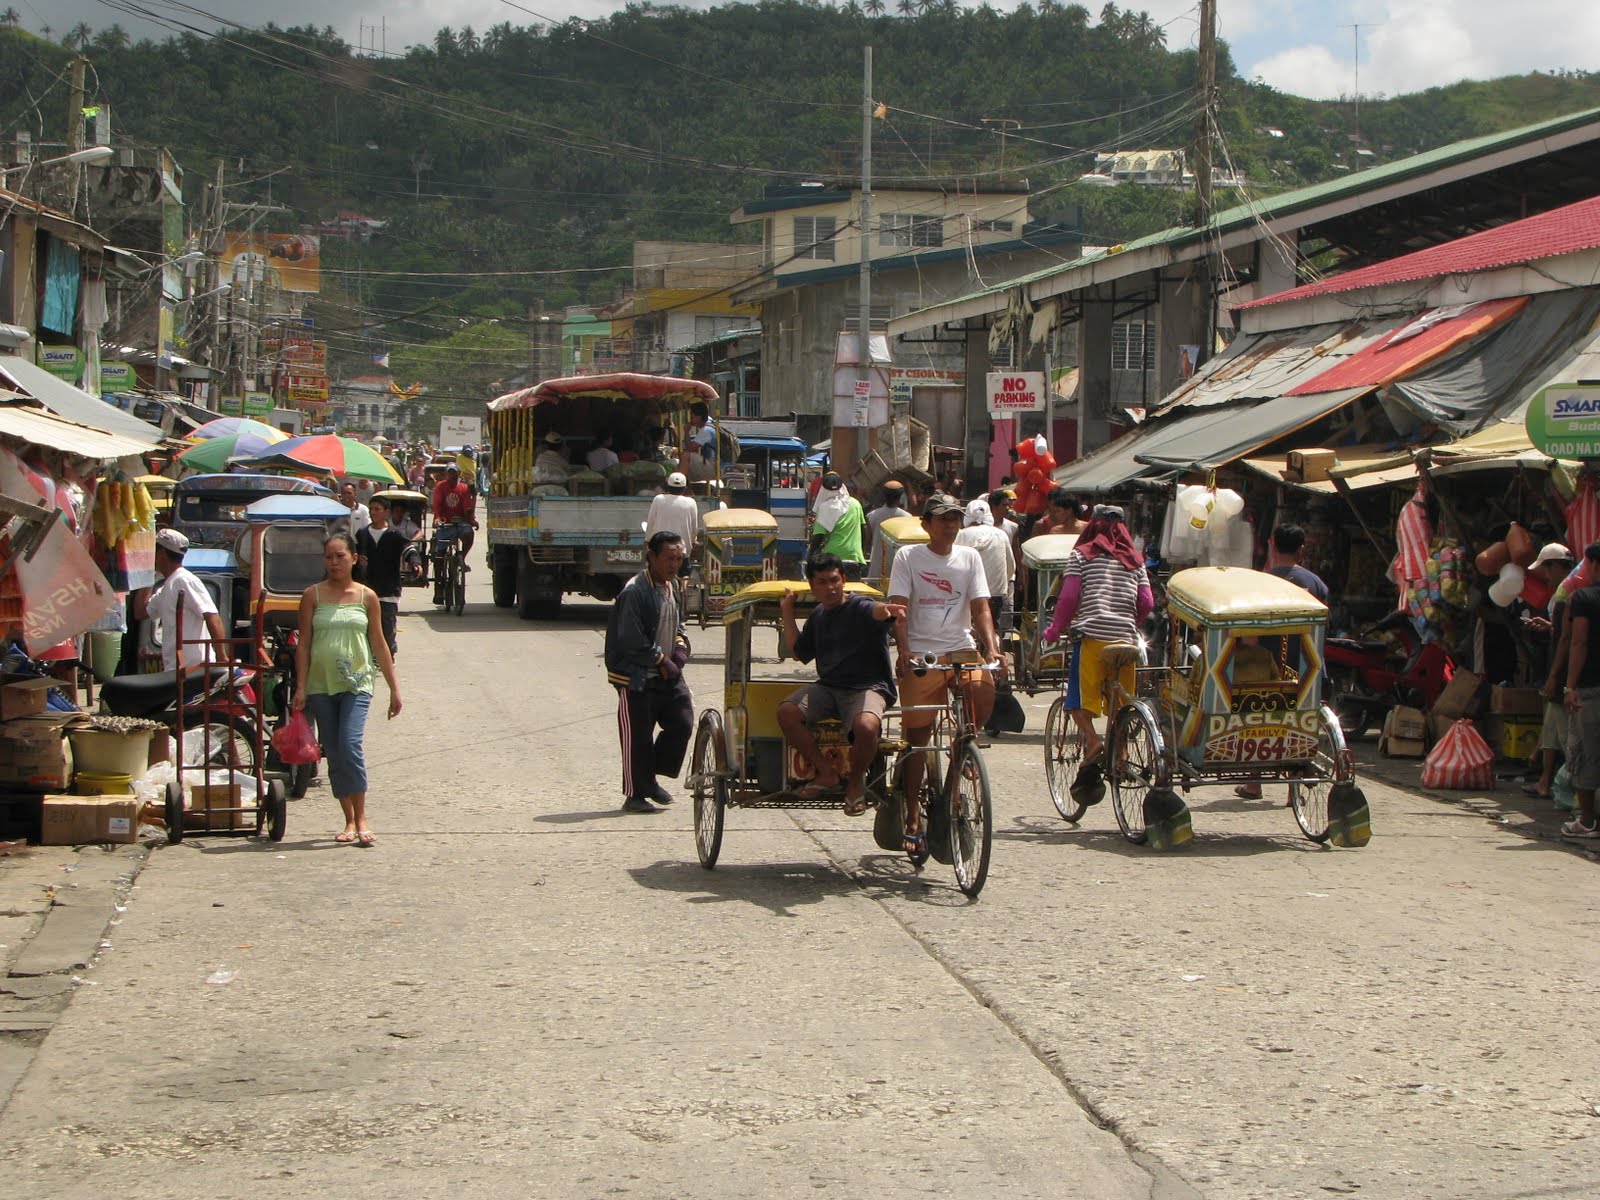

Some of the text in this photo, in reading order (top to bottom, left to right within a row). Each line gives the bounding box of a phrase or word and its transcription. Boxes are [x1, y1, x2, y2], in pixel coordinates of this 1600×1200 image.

[1003, 377, 1026, 391] NO
[994, 392, 1036, 403] PARKING
[1545, 442, 1574, 454] LOAD
[1576, 442, 1591, 454] NA
[1209, 711, 1318, 737] DACLAG
[1245, 729, 1280, 738] FAMILY
[1235, 737, 1286, 761] 1964
